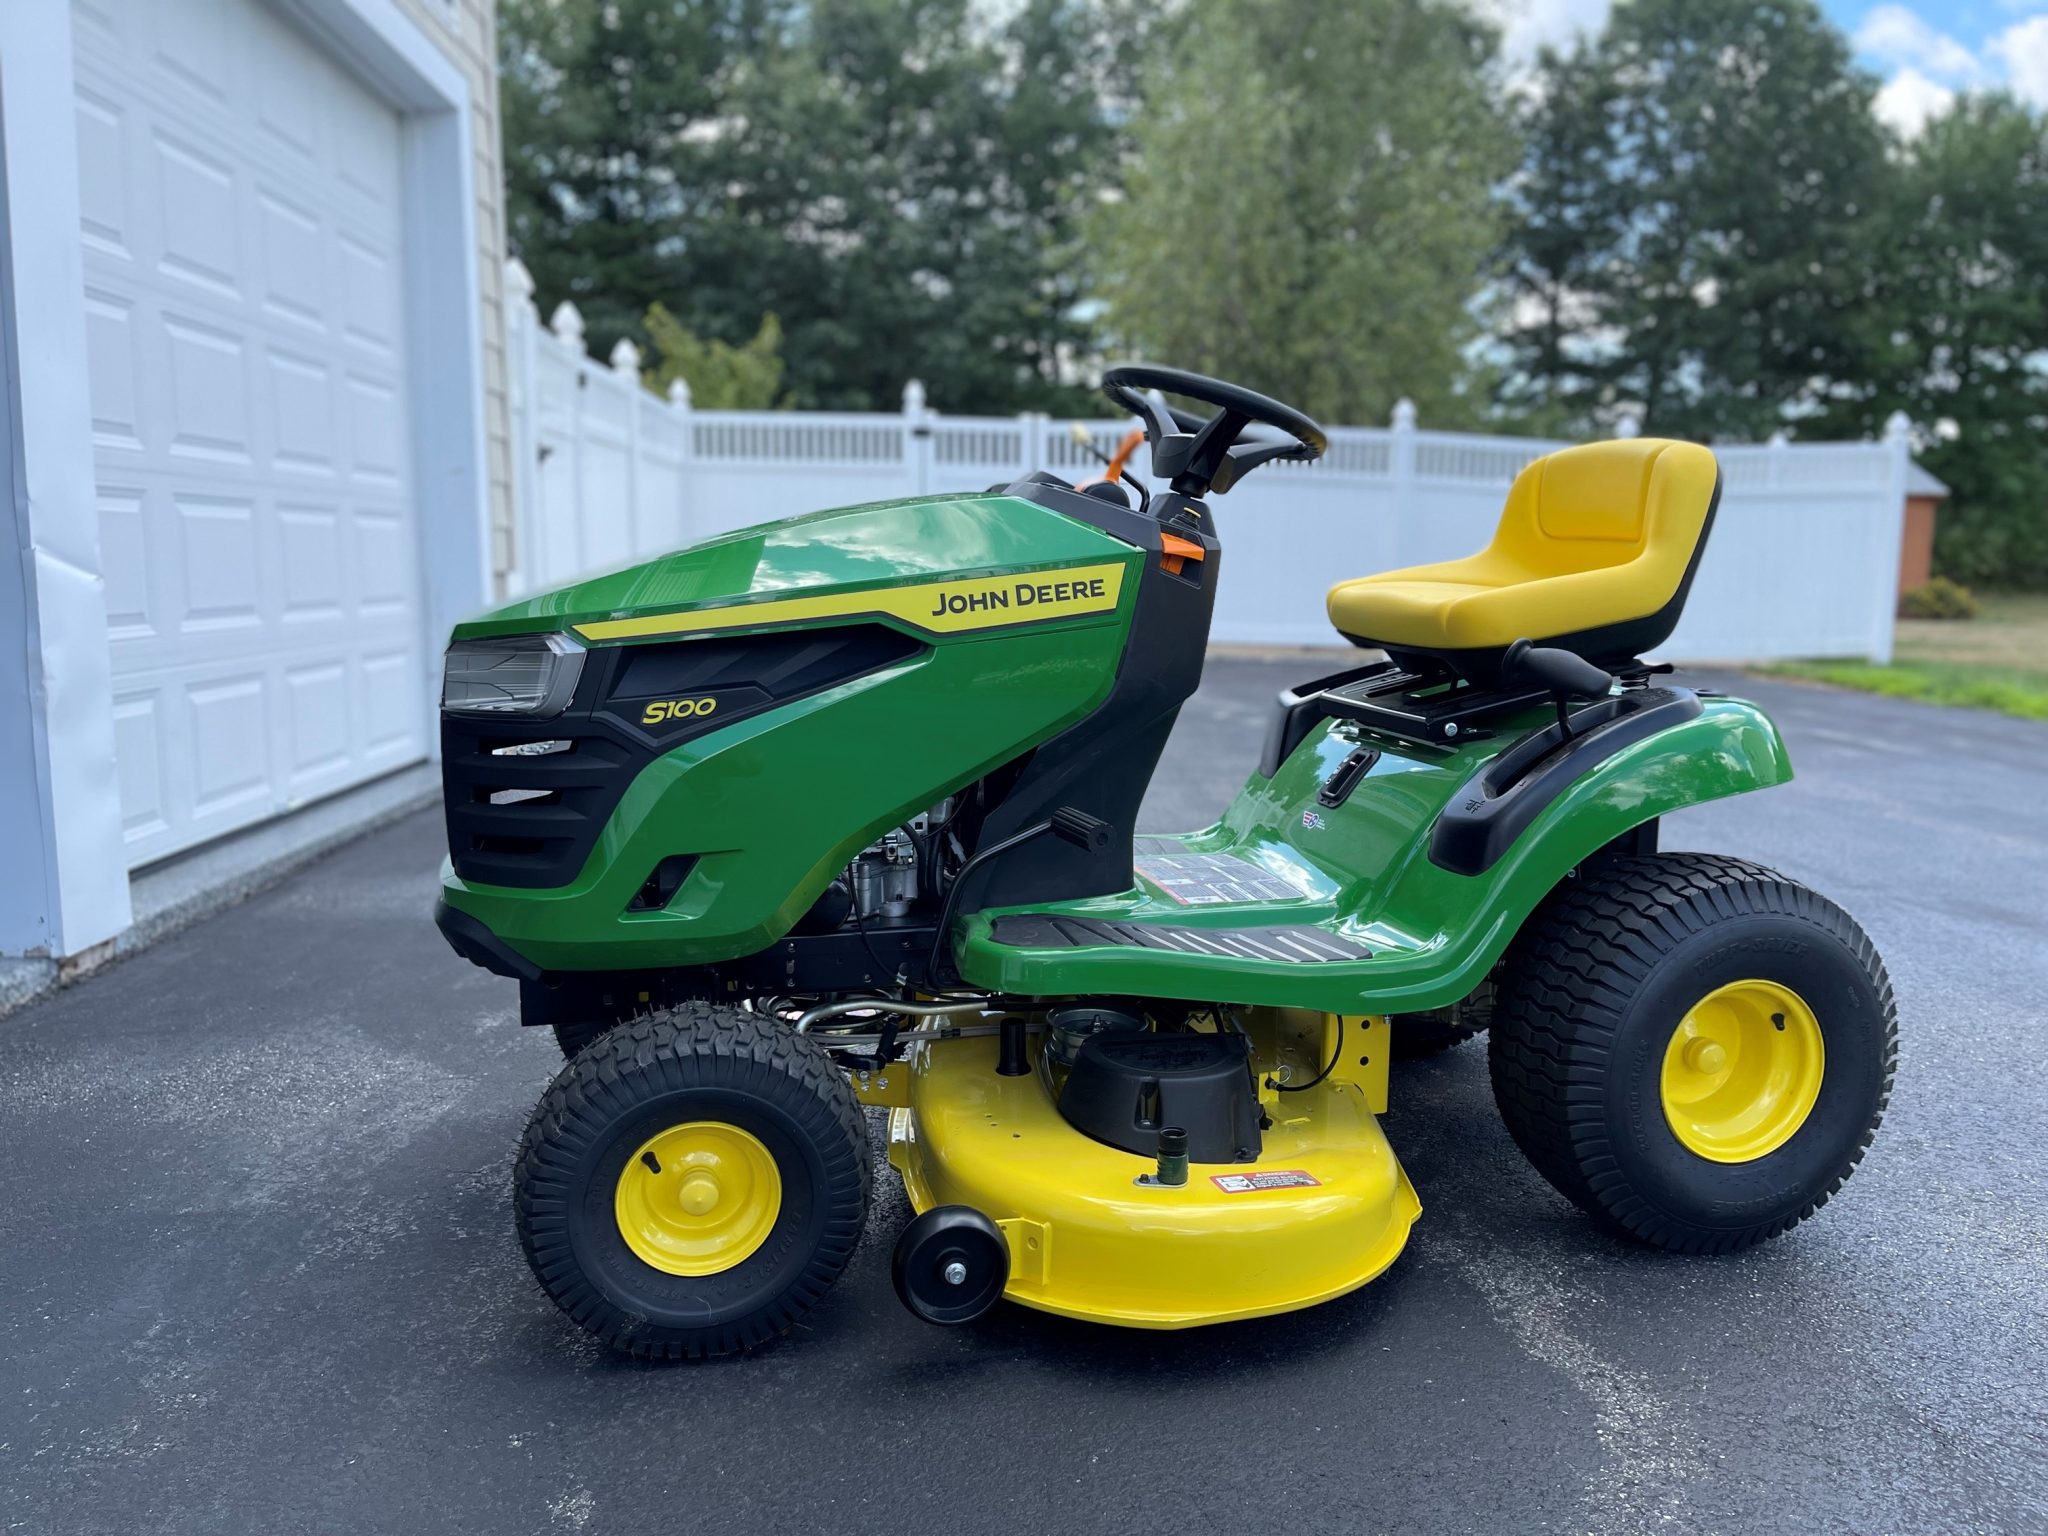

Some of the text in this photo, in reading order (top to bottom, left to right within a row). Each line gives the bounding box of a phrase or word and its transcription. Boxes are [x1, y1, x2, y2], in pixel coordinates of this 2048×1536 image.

[932, 579, 1105, 617] JOHN DEERE
[642, 698, 717, 724] S100
